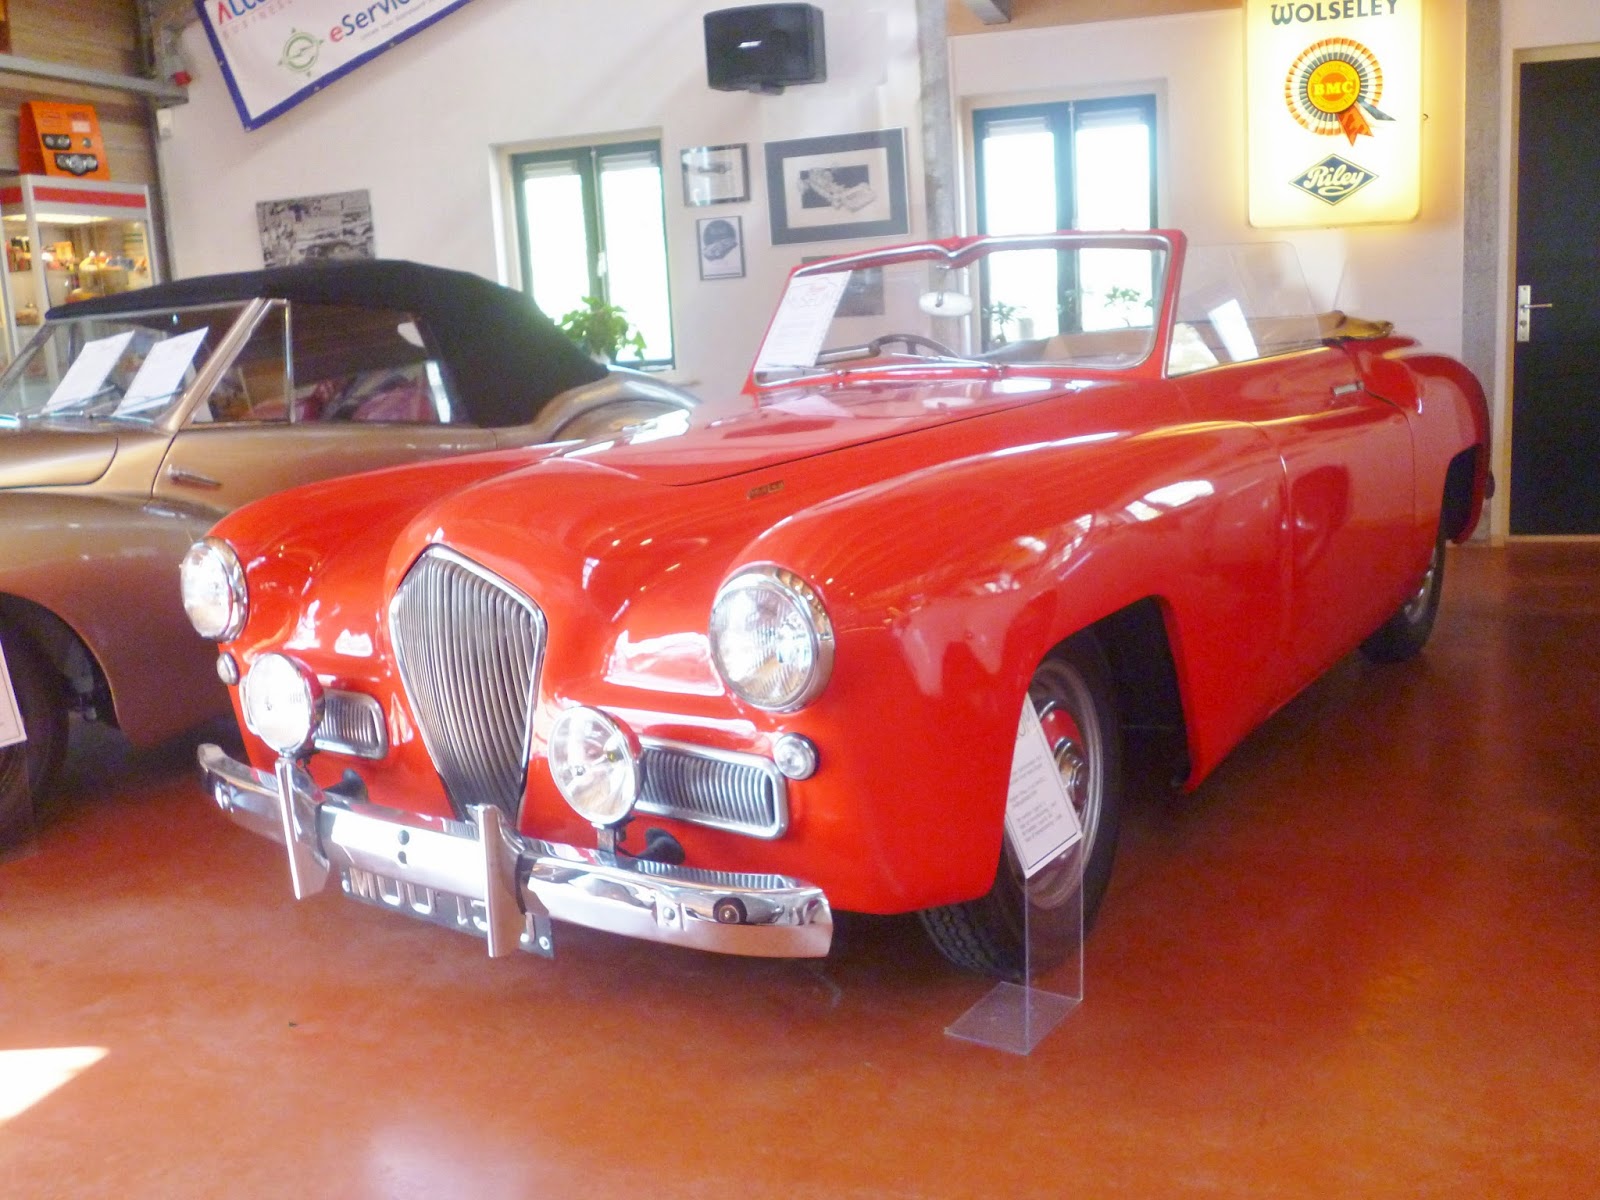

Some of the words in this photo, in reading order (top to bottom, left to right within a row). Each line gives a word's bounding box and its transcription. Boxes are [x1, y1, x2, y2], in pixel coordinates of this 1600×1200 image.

[1271, 0, 1397, 26] WOLSELEY
[1312, 80, 1355, 97] BMC
[1303, 164, 1364, 196] Riley
